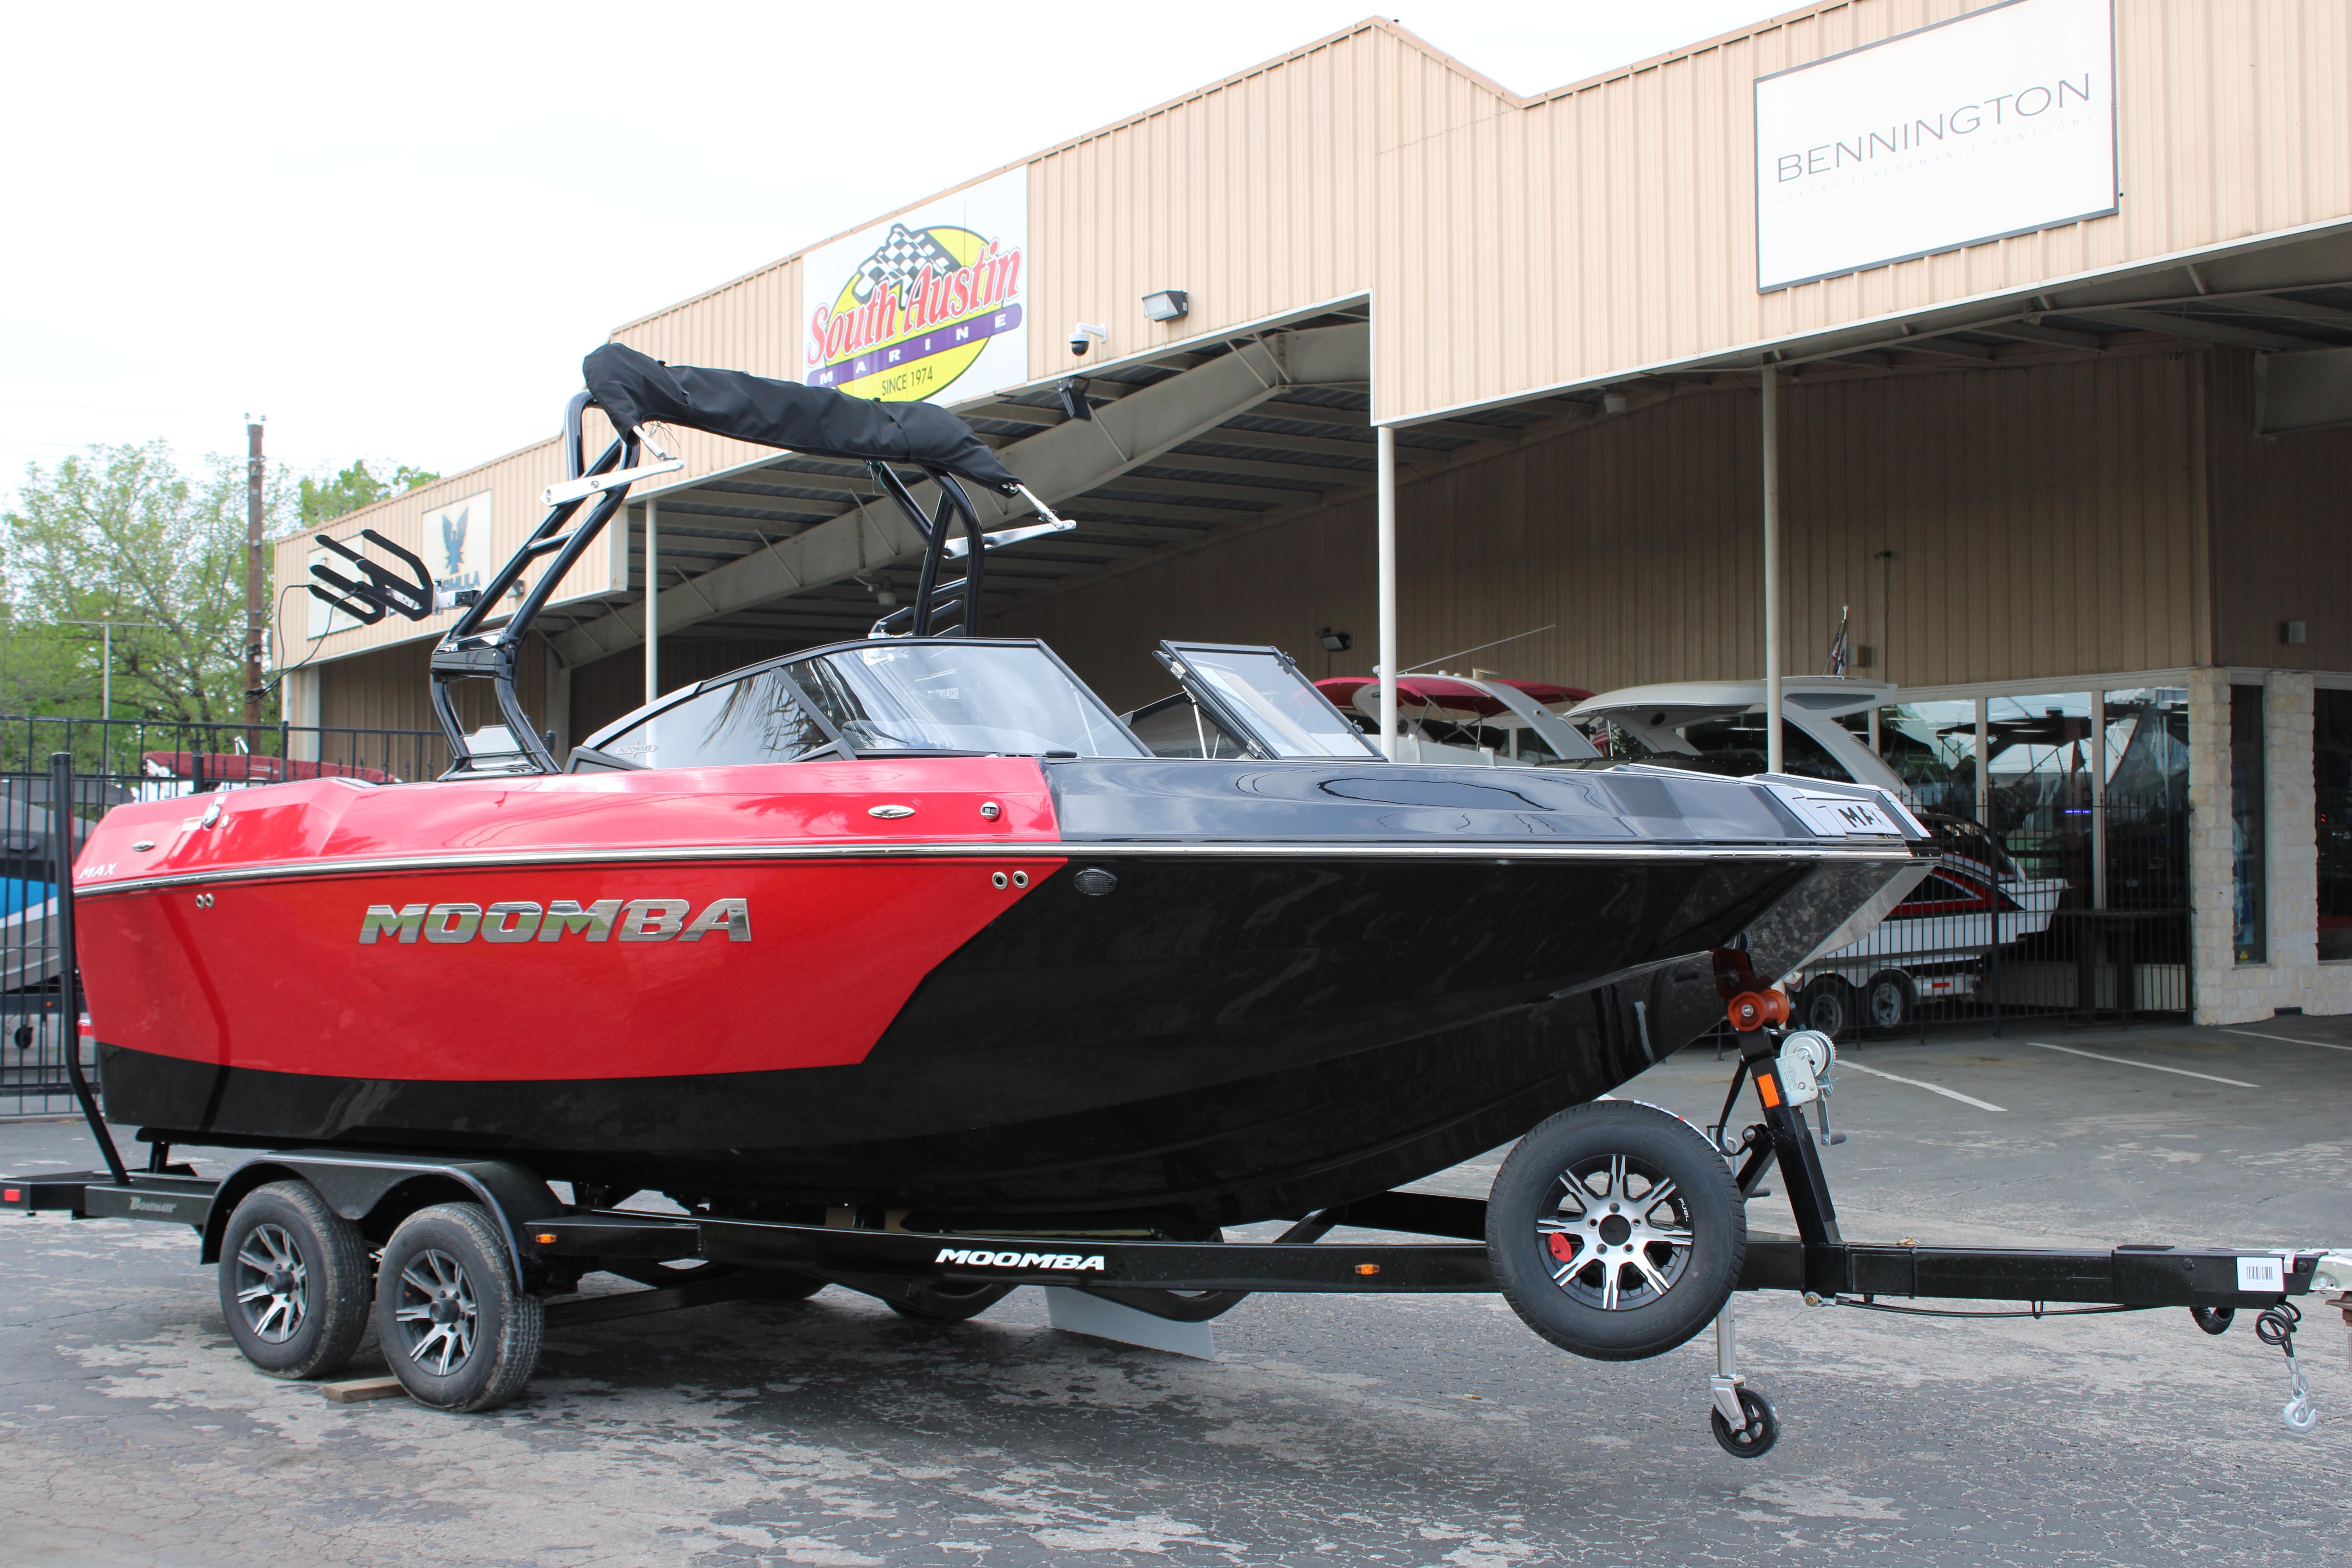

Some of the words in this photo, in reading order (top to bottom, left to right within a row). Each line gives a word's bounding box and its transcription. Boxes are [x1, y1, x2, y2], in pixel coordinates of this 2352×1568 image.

[1778, 72, 2091, 183] BENNINGTON
[1777, 182, 1837, 203] LUXURY
[1851, 145, 1976, 185] PERFORMANCE
[1992, 114, 2092, 147] PONTOONS
[806, 281, 897, 366] South
[902, 237, 1022, 334] Austin
[820, 314, 1006, 385] MARINE
[882, 373, 906, 396] SINCE
[911, 365, 933, 387] 1974
[619, 745, 652, 753] AUTOWAKE
[1837, 806, 1889, 828] MAX
[78, 863, 119, 880] MAX
[358, 898, 752, 944] MOOMBA
[1678, 1198, 1689, 1222] FUEL
[935, 1249, 1105, 1270] MOOMBA
